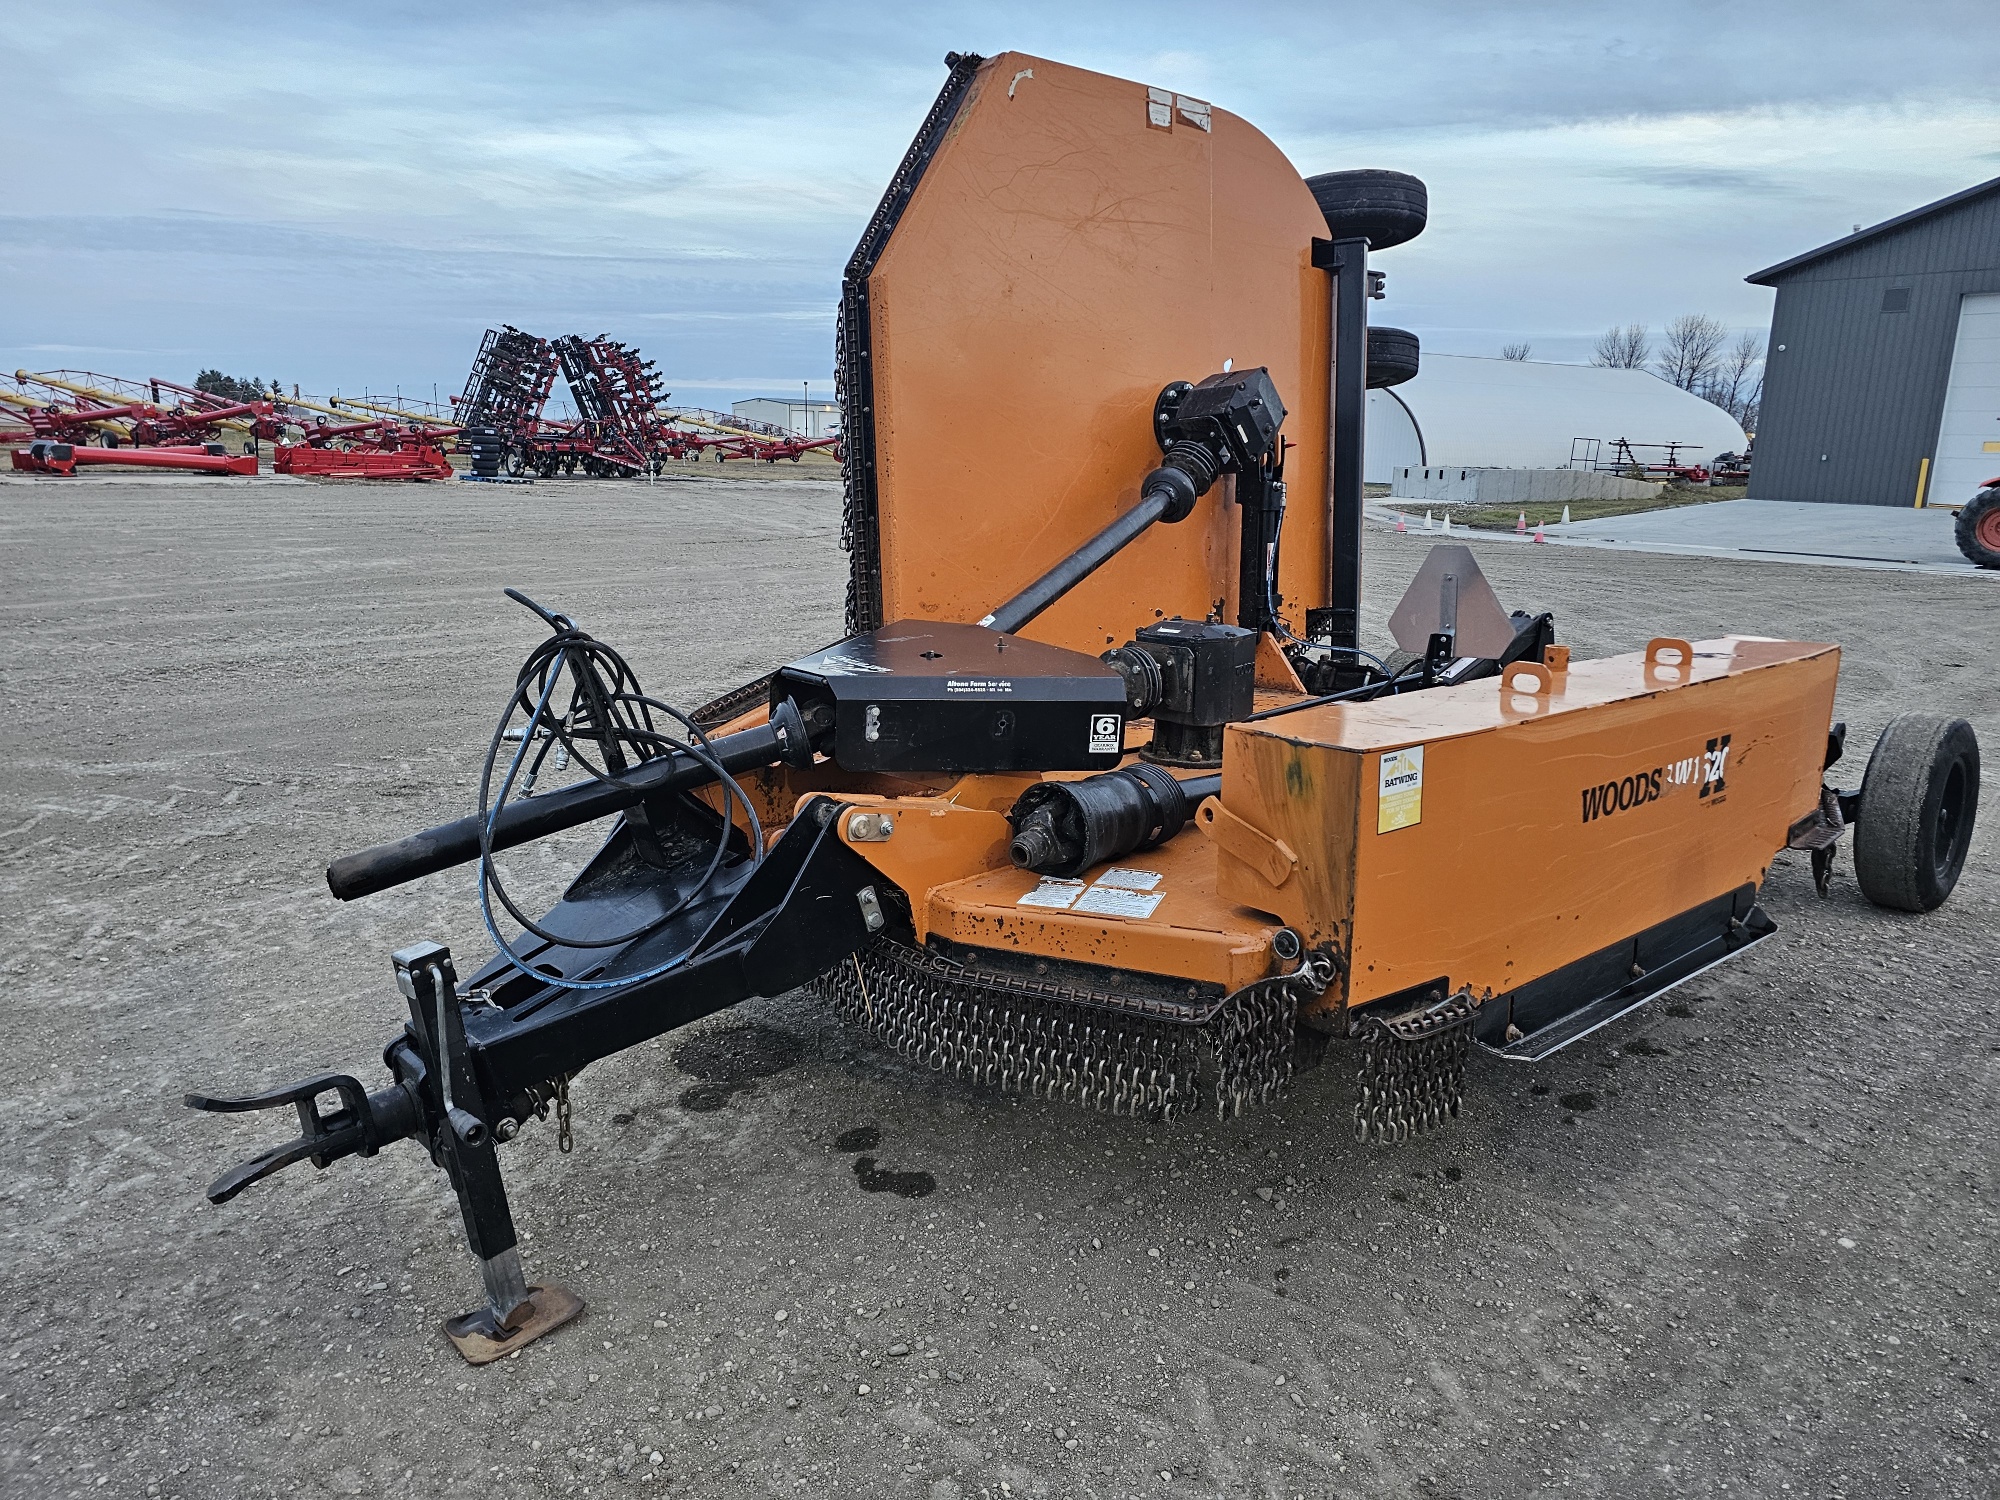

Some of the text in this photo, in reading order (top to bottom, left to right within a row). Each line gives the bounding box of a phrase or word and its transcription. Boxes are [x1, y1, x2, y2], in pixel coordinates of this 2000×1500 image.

[1096, 717, 1115, 735] 6
[1384, 773, 1418, 788] BATWING
[1582, 767, 1663, 823] WOODS
